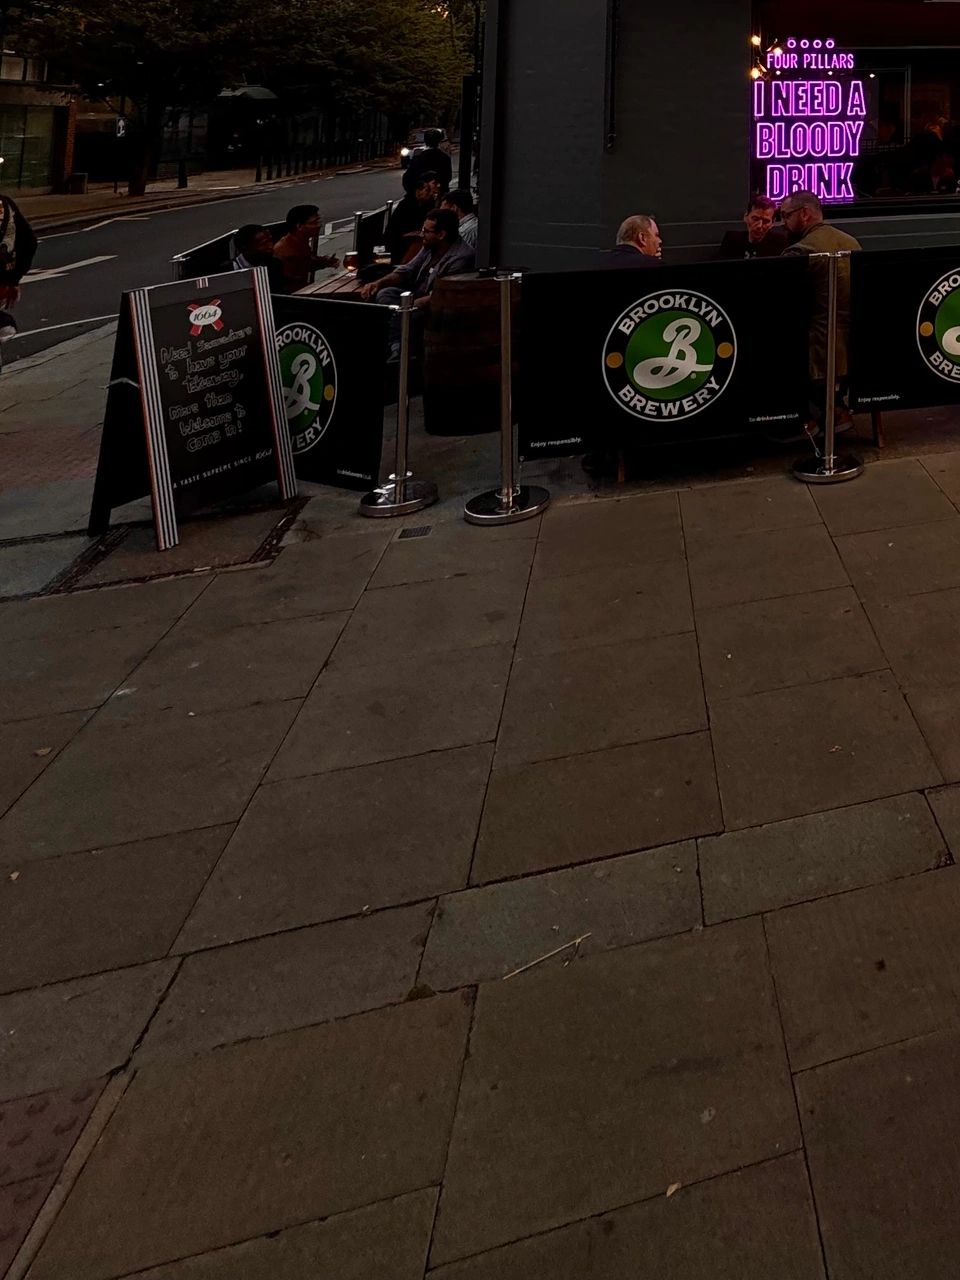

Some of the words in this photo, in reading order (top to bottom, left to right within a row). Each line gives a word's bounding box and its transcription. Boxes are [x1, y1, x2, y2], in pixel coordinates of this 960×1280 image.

[767, 53, 798, 69] FOUR
[803, 53, 854, 69] PILLARS
[754, 81, 764, 116] I
[771, 81, 842, 116] NEED
[847, 81, 866, 115] A
[756, 121, 864, 158] BLOODY
[766, 162, 854, 200] DRINK
[618, 294, 723, 336] BROOKLYN
[161, 341, 192, 364] Need
[219, 345, 248, 369] your
[275, 328, 331, 367] ROOKLYN
[617, 376, 720, 417] BREWERY
